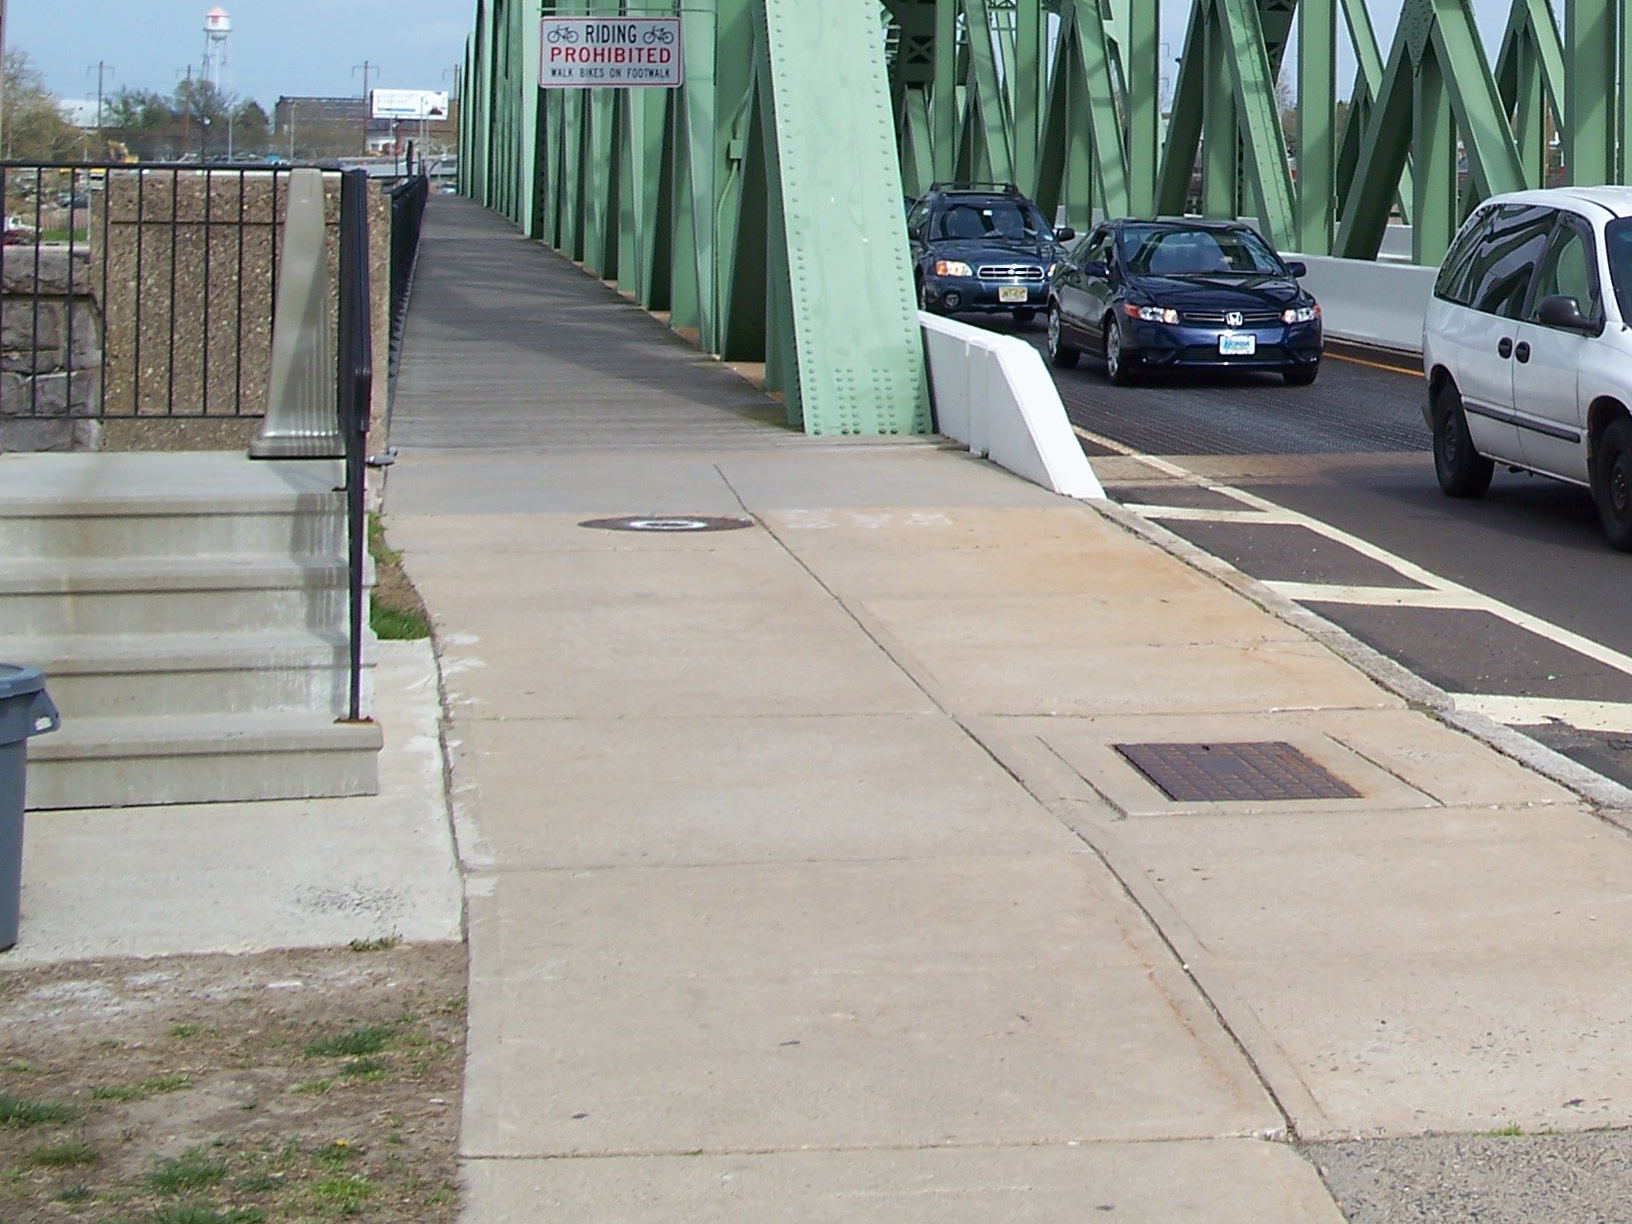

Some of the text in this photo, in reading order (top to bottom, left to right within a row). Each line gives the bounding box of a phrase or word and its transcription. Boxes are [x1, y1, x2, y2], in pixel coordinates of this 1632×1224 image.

[585, 24, 637, 44] RIDING
[550, 47, 671, 64] PROHIBITED
[551, 68, 670, 78] WALK BIKES ON FOOTWALK
